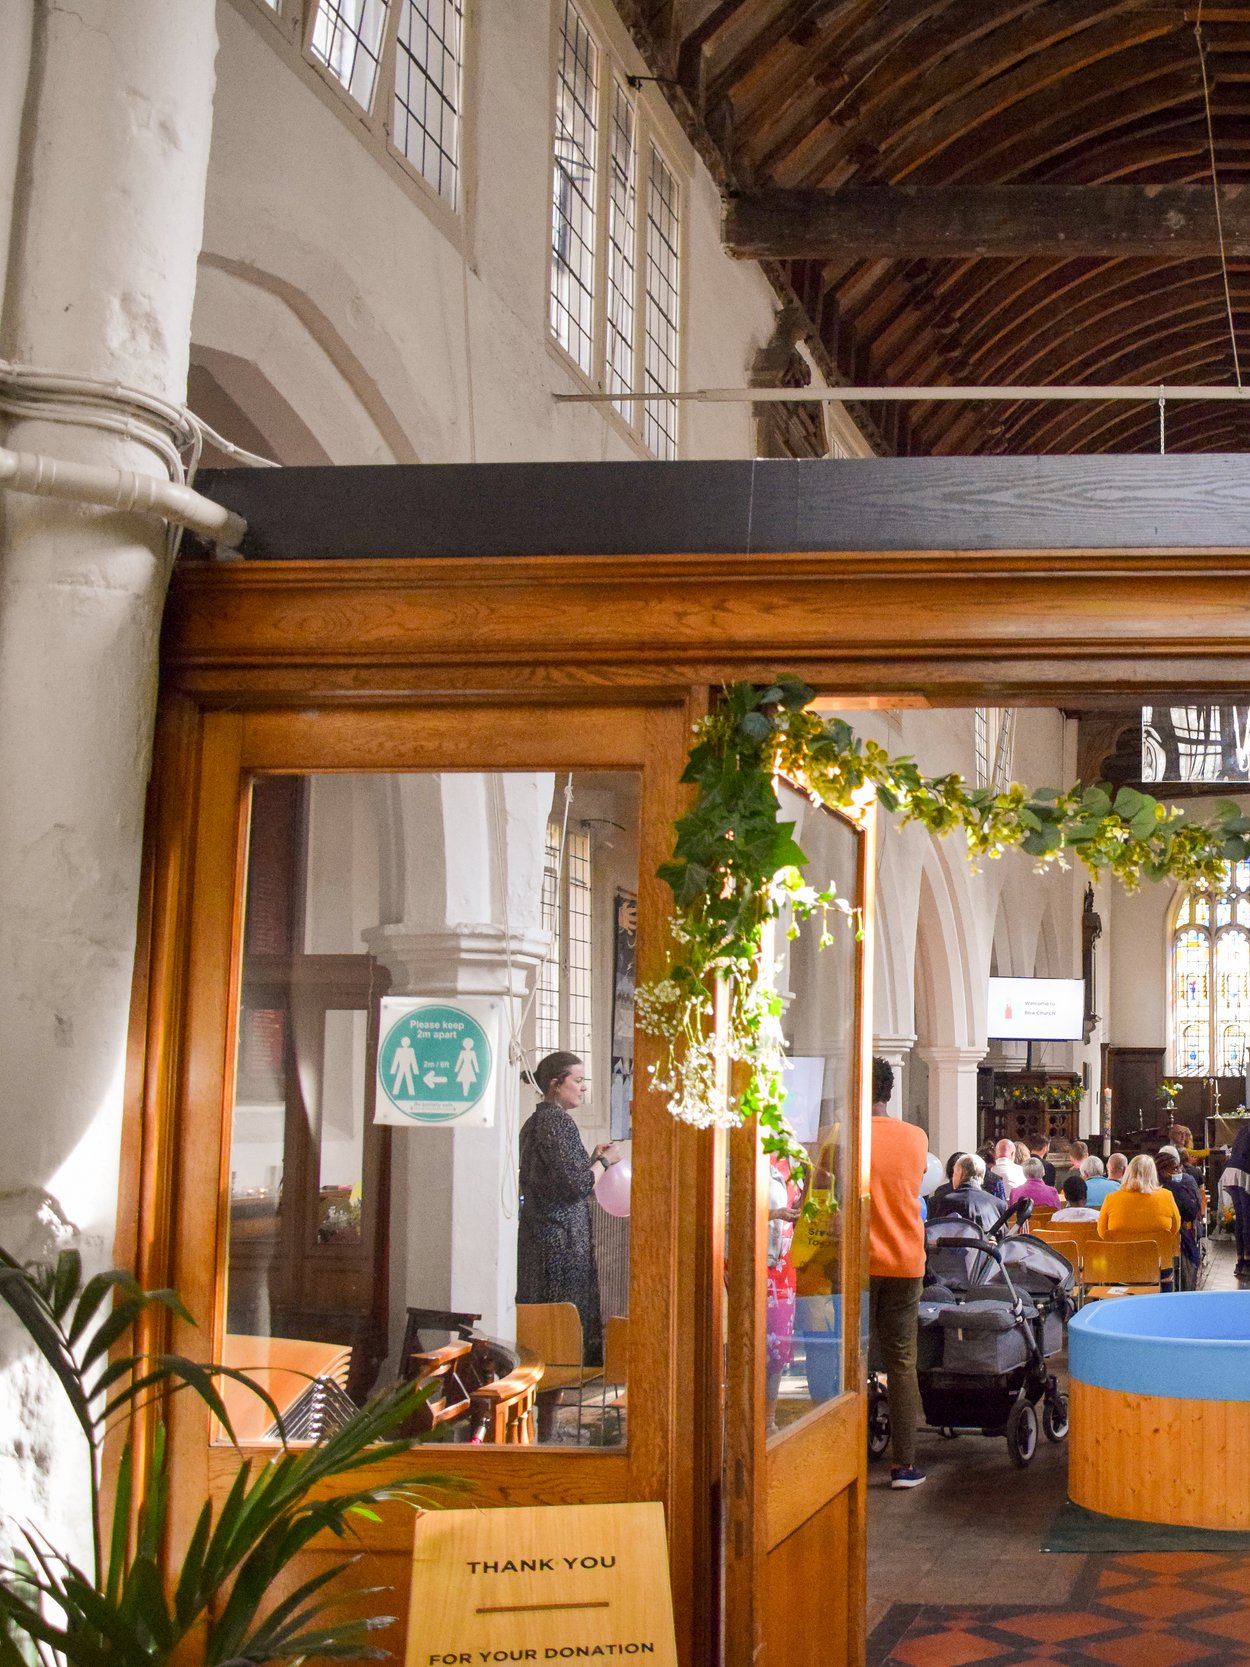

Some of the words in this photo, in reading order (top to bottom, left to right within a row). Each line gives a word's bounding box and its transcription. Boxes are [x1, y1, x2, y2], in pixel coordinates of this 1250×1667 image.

[410, 1020, 441, 1029] Please
[442, 1021, 465, 1031] keep
[417, 1030, 431, 1038] 2m
[433, 1031, 457, 1039] apart
[466, 1558, 554, 1574] THANK
[563, 1555, 616, 1570] YOU
[429, 1653, 472, 1666] FOR
[479, 1649, 537, 1662] YOUR
[544, 1642, 655, 1659] DONATION
